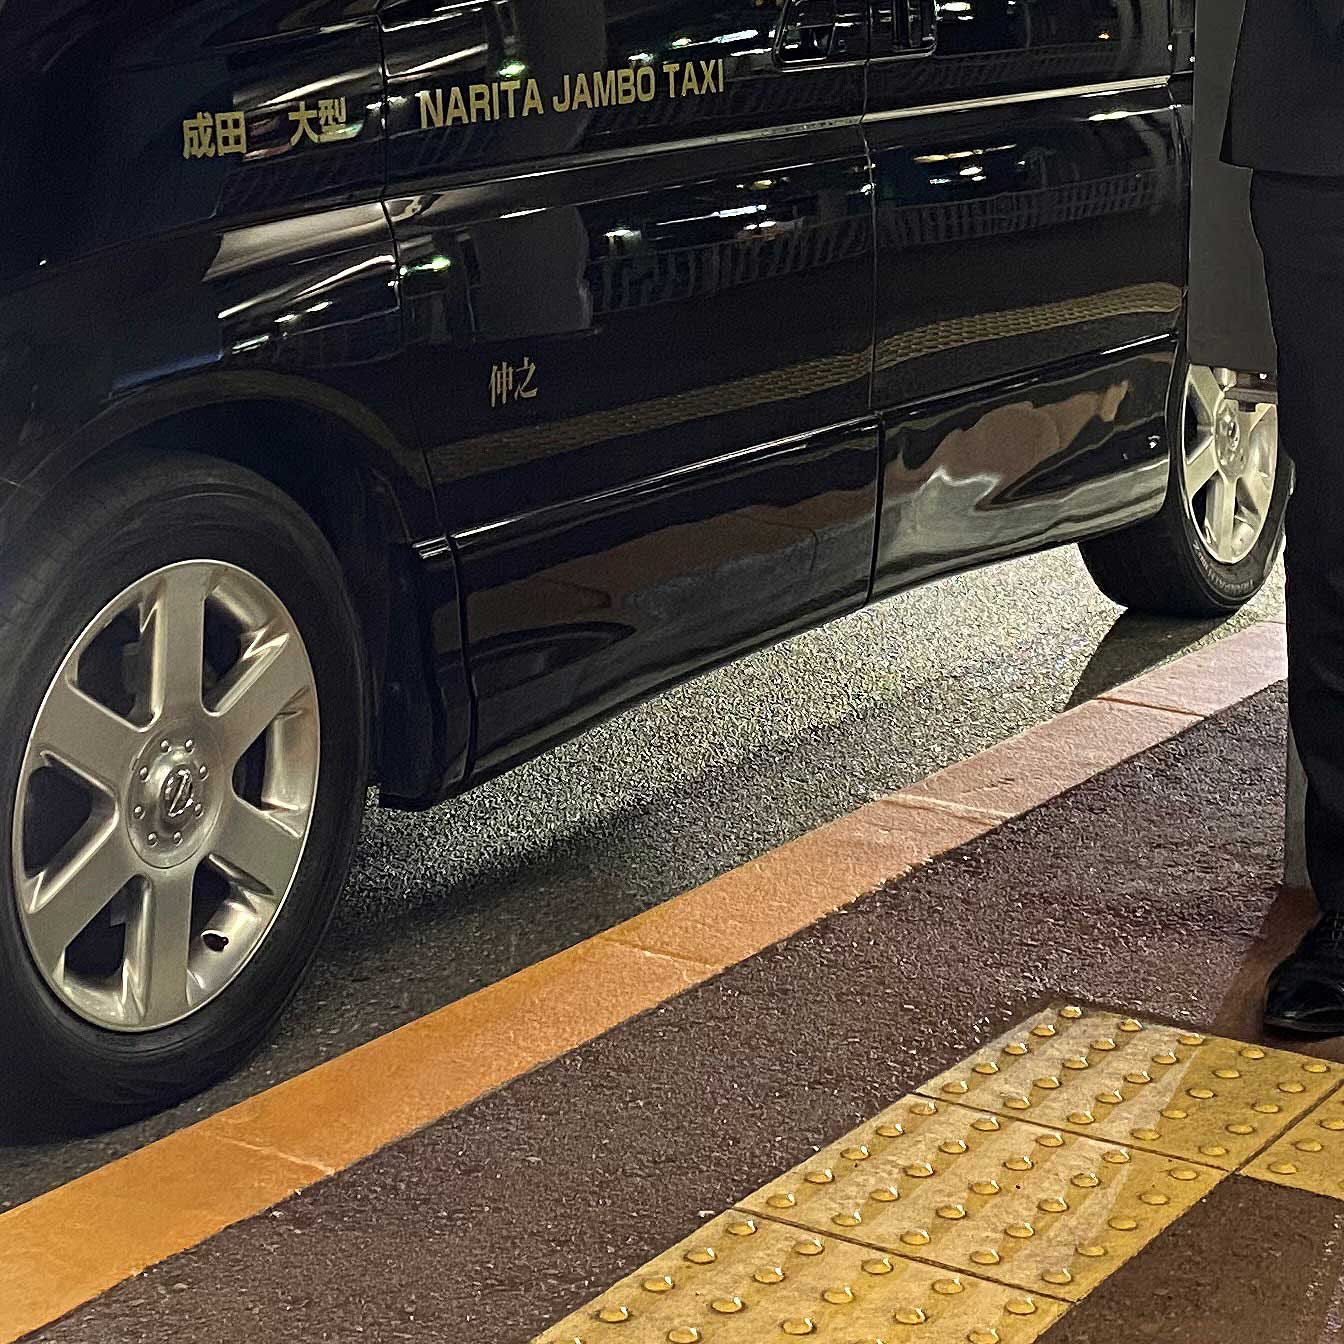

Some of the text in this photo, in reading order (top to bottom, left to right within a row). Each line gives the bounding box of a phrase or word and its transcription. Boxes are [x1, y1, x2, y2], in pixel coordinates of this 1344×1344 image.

[182, 95, 350, 160] 成田 大型
[419, 58, 724, 130] NARITA JAMBO TAXI
